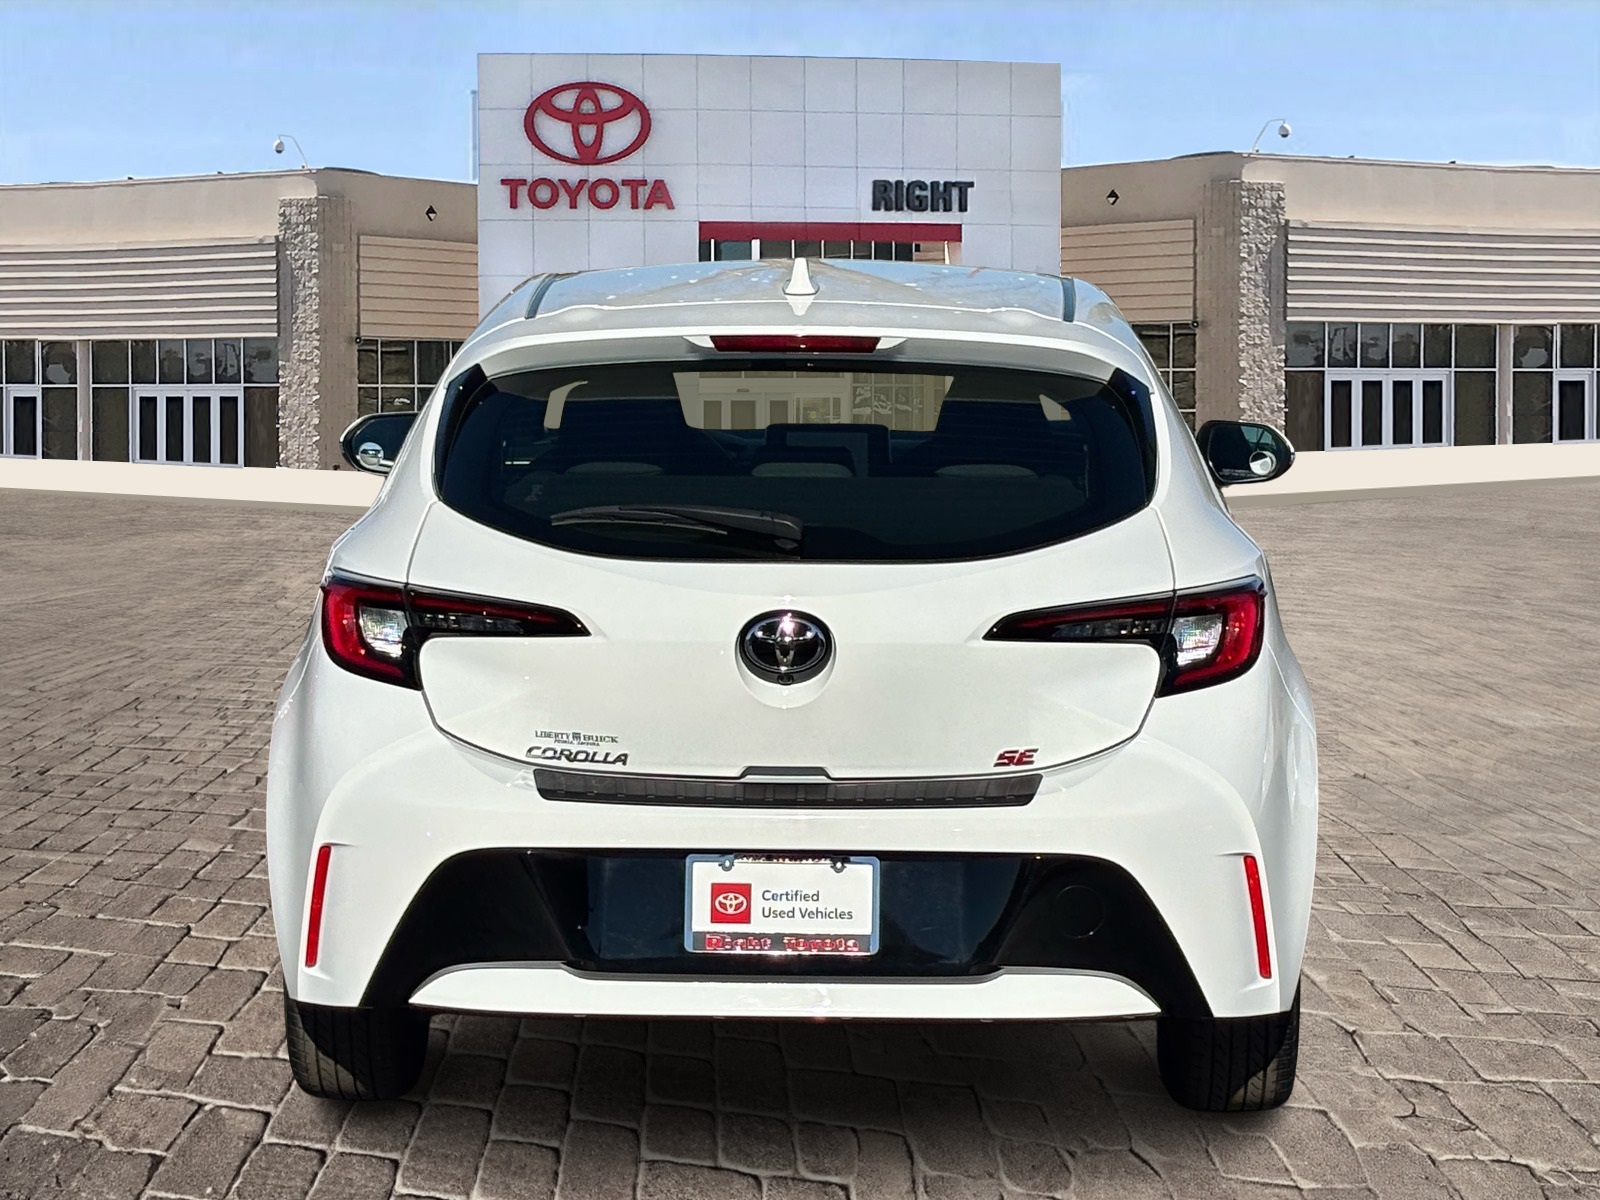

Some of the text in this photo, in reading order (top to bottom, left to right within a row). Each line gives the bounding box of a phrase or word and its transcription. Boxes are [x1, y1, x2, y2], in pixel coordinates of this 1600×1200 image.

[500, 178, 675, 210] TOYOTA
[871, 179, 975, 213] RIGHT
[535, 730, 619, 743] LIBERTY BUICK
[525, 745, 629, 766] COROLLA
[993, 748, 1039, 767] SE
[761, 890, 820, 902] Certified
[761, 907, 853, 920] Used Vehicles
